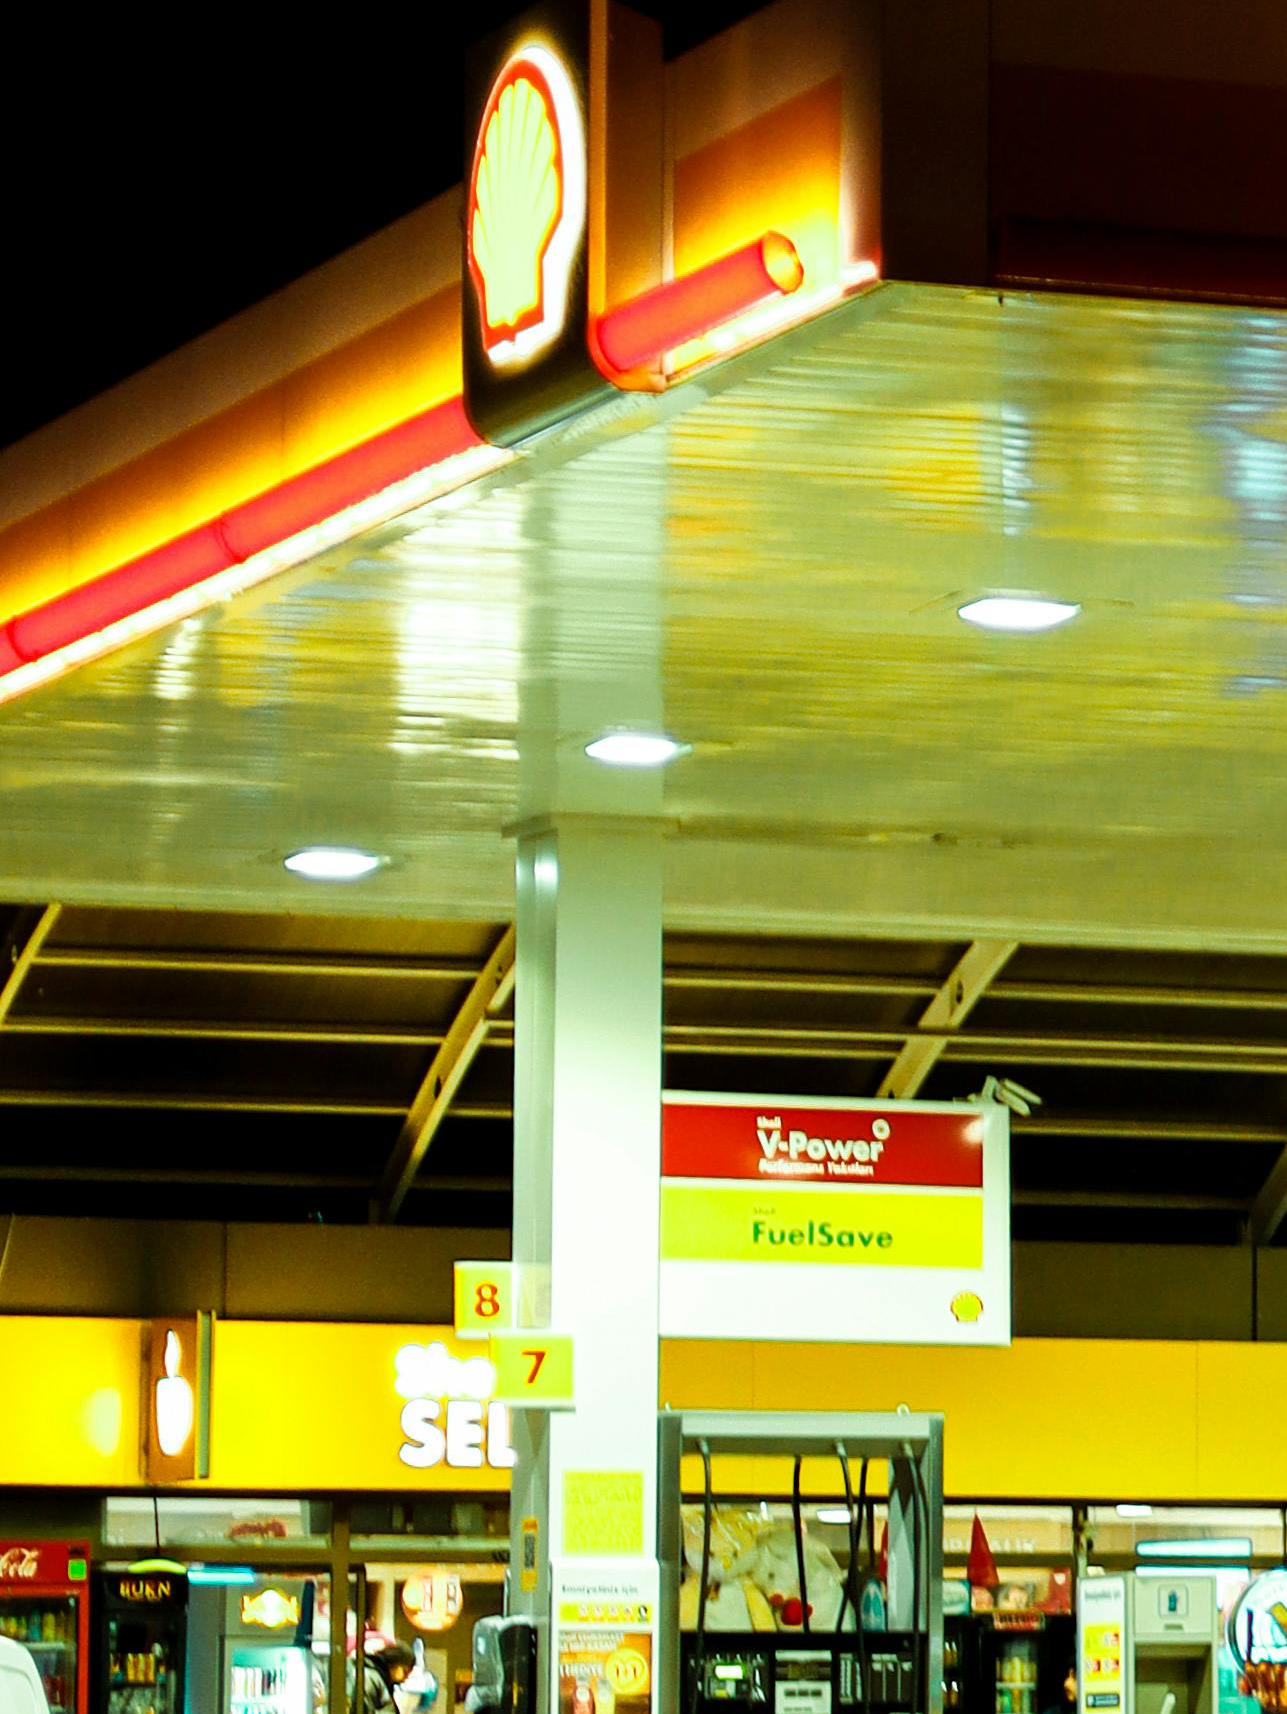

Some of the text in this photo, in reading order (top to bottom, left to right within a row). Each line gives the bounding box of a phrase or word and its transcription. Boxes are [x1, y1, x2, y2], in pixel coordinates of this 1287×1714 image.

[756, 1129, 885, 1163] V-Power
[752, 1219, 894, 1249] FuelSave
[474, 1283, 500, 1318] 8
[521, 1350, 547, 1385] 7
